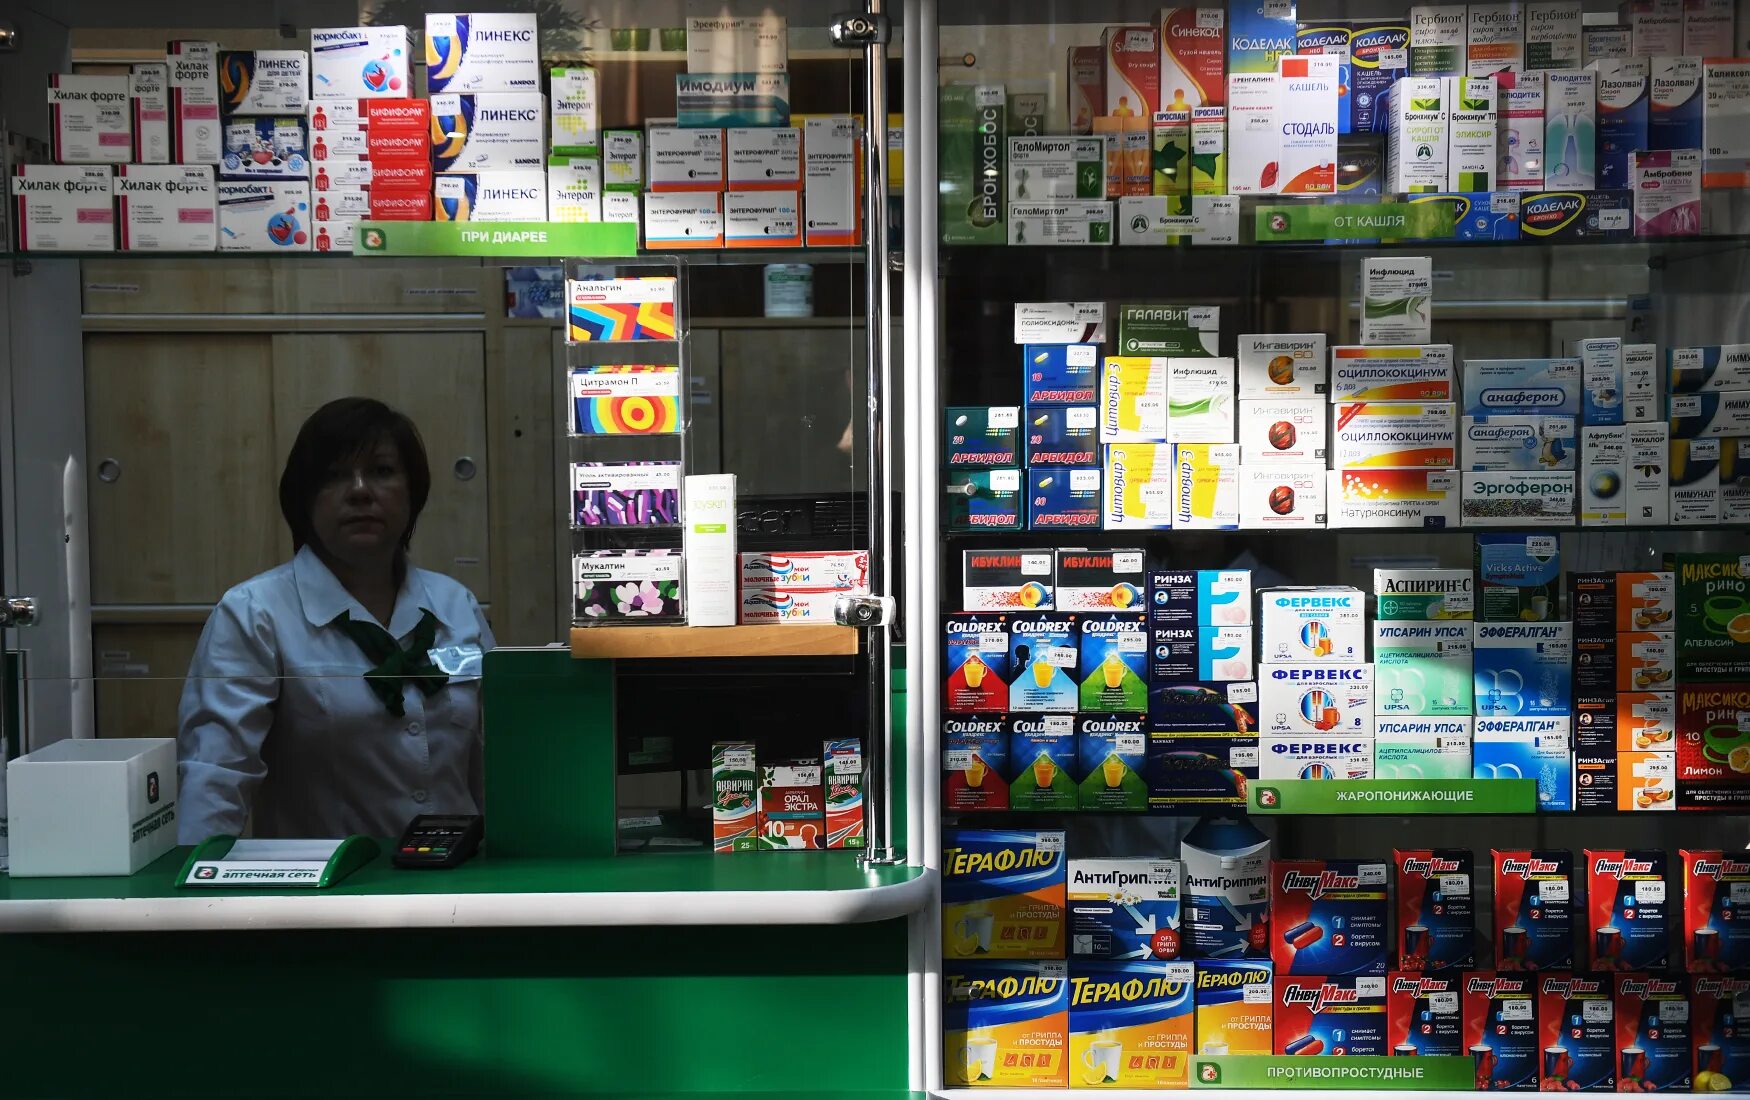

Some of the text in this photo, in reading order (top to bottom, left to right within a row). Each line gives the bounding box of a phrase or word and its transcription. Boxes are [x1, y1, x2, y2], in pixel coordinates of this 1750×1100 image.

[1415, 14, 1461, 26] Гербион
[1473, 12, 1519, 24] Гербион
[1531, 10, 1578, 23] Гербион
[314, 30, 362, 43] нормобакт
[476, 29, 531, 42] ЛИНЕКС
[1171, 24, 1220, 39] Синекод
[1233, 36, 1291, 51] КОДЕЛАК
[176, 60, 209, 71] Хилак
[176, 71, 209, 82] форте
[1550, 74, 1592, 84] Флюдитек
[679, 78, 755, 94] Имодиум
[1289, 82, 1329, 92] КАШЕЛЬ
[1601, 79, 1643, 90] Лазолван
[1654, 78, 1696, 89] Лазолван
[54, 90, 125, 103] Хилак форте
[556, 100, 591, 111] Энтерол
[480, 109, 536, 121] ЛИНЕКС
[1157, 112, 1185, 121] ПРОСПАН
[1282, 122, 1335, 137] СТОДАЛЬ
[1456, 130, 1492, 139] ЭЛИКСИР
[1013, 140, 1070, 154] ГелоМиртол
[1643, 168, 1693, 178] Амбробене
[19, 179, 59, 191] Хилак
[121, 179, 161, 191] Хилак
[483, 187, 538, 200] ЛИНЕКС
[556, 190, 594, 201] Энтерол
[1013, 206, 1066, 218] ГелоМиртол
[1527, 199, 1579, 214] КОДЕЛАК
[1335, 215, 1405, 228] ОТ КАШЛЯ
[462, 230, 548, 244] ПРИ ДИАРЕЕ
[1370, 268, 1415, 280] Инфлюцид
[576, 283, 622, 293] Анальгин
[1253, 340, 1313, 351] Ингавирин
[1173, 367, 1218, 378] Инфлюцид
[1337, 367, 1446, 380] ОЦИЛЛОКОКЦИНУМ
[580, 376, 638, 389] Цитрамон П
[1031, 389, 1094, 402] АРБИДОЛ
[1106, 363, 1121, 437] Цитовир-3
[1487, 389, 1558, 405] анаферон
[1253, 406, 1313, 417] Ингавирин
[1341, 432, 1453, 443] ОЦИЛЛОКОКЦИНУМ
[1474, 426, 1530, 439] анаферон
[1588, 432, 1624, 441] Афлубин
[1631, 437, 1665, 445] УМКАЛОР
[951, 452, 1013, 464] АРБИДОЛ
[1031, 452, 1093, 464] АРБИДОЛ
[1253, 471, 1313, 482] Ингавирин
[1111, 450, 1126, 523] Цитовир-3
[1178, 450, 1193, 523] Цитовир-3
[1473, 481, 1573, 497] Эргоферон
[1674, 490, 1714, 499] ИММУНАЛ
[1341, 507, 1421, 520] Натуркоксинум
[1035, 514, 1098, 526] АРБИДОЛ
[582, 561, 625, 571] Мукалтин
[971, 555, 1022, 569] ИБУКЛИН
[1063, 555, 1113, 569] ИБУКЛИН
[1486, 562, 1545, 573] Vicks Active
[781, 572, 810, 584] зубки
[1154, 575, 1192, 584] РИНЗА
[1275, 597, 1351, 608] ФЕРВЕКС
[1690, 603, 1698, 613] 5
[781, 607, 810, 619] зубки
[946, 620, 1002, 634] COLDREX
[1012, 620, 1072, 634] COLDREX
[1082, 620, 1141, 634] COLDREX
[1379, 626, 1464, 638] УПСАРИН УПСА
[1479, 626, 1558, 639] ЭФФЕРАЛГАН
[1155, 629, 1193, 639] РИНЗА
[1684, 638, 1734, 648] АПЕЛЬСИН
[1347, 646, 1353, 654] 8
[1271, 669, 1362, 680] ФЕРВЕКС
[1384, 703, 1410, 711] UPSA
[1481, 703, 1507, 711] UPSA
[945, 720, 1001, 733] COLDREX
[1013, 720, 1047, 733] COLD
[1378, 723, 1464, 734] УПСАРИН УПСА
[1477, 720, 1556, 733] ЭФФЕРАЛГАН
[1685, 732, 1700, 742] 10
[1271, 743, 1362, 754] ФЕРВЕКС
[1683, 766, 1723, 776] ЛИМОН
[784, 794, 810, 804] ОРАЛ
[1336, 790, 1475, 804] ЖАРОПОНИЖАЮЩИЕ
[784, 802, 819, 812] ЭКСТРА
[131, 817, 162, 843] аптечная
[162, 809, 176, 830] сеть
[765, 820, 785, 838] 10
[943, 847, 1055, 877] ТЕРАФЛЮ
[1402, 858, 1460, 876] АнвиМакс
[1502, 858, 1559, 876] АнвиМакс
[1595, 858, 1653, 877] АнвиМакс
[222, 869, 317, 882] аптечная сеть
[1185, 873, 1267, 892] АнтиГриппин
[1282, 871, 1359, 896] АнвиМакс
[1334, 933, 1375, 946] 2 борется
[1197, 969, 1268, 990] ТЕРАФЛЮ
[1070, 972, 1183, 1006] ТЕРАФЛЮ
[1392, 977, 1448, 996] АнвиМакс
[1282, 984, 1359, 1009] АнвиМакс
[1239, 1015, 1272, 1024] ГРИППА
[1227, 1022, 1272, 1032] ПРОСТУДЫ
[1031, 1031, 1063, 1041] ГРИППА
[1156, 1033, 1188, 1042] ГРИППА
[1019, 1039, 1063, 1049] ПРОСТУДЫ
[1144, 1040, 1188, 1051] ПРОСТУДЫ
[1267, 1066, 1424, 1081] ПРОТИВОПРОСТУДНЫЕ
[1608, 1077, 1614, 1086] 6
